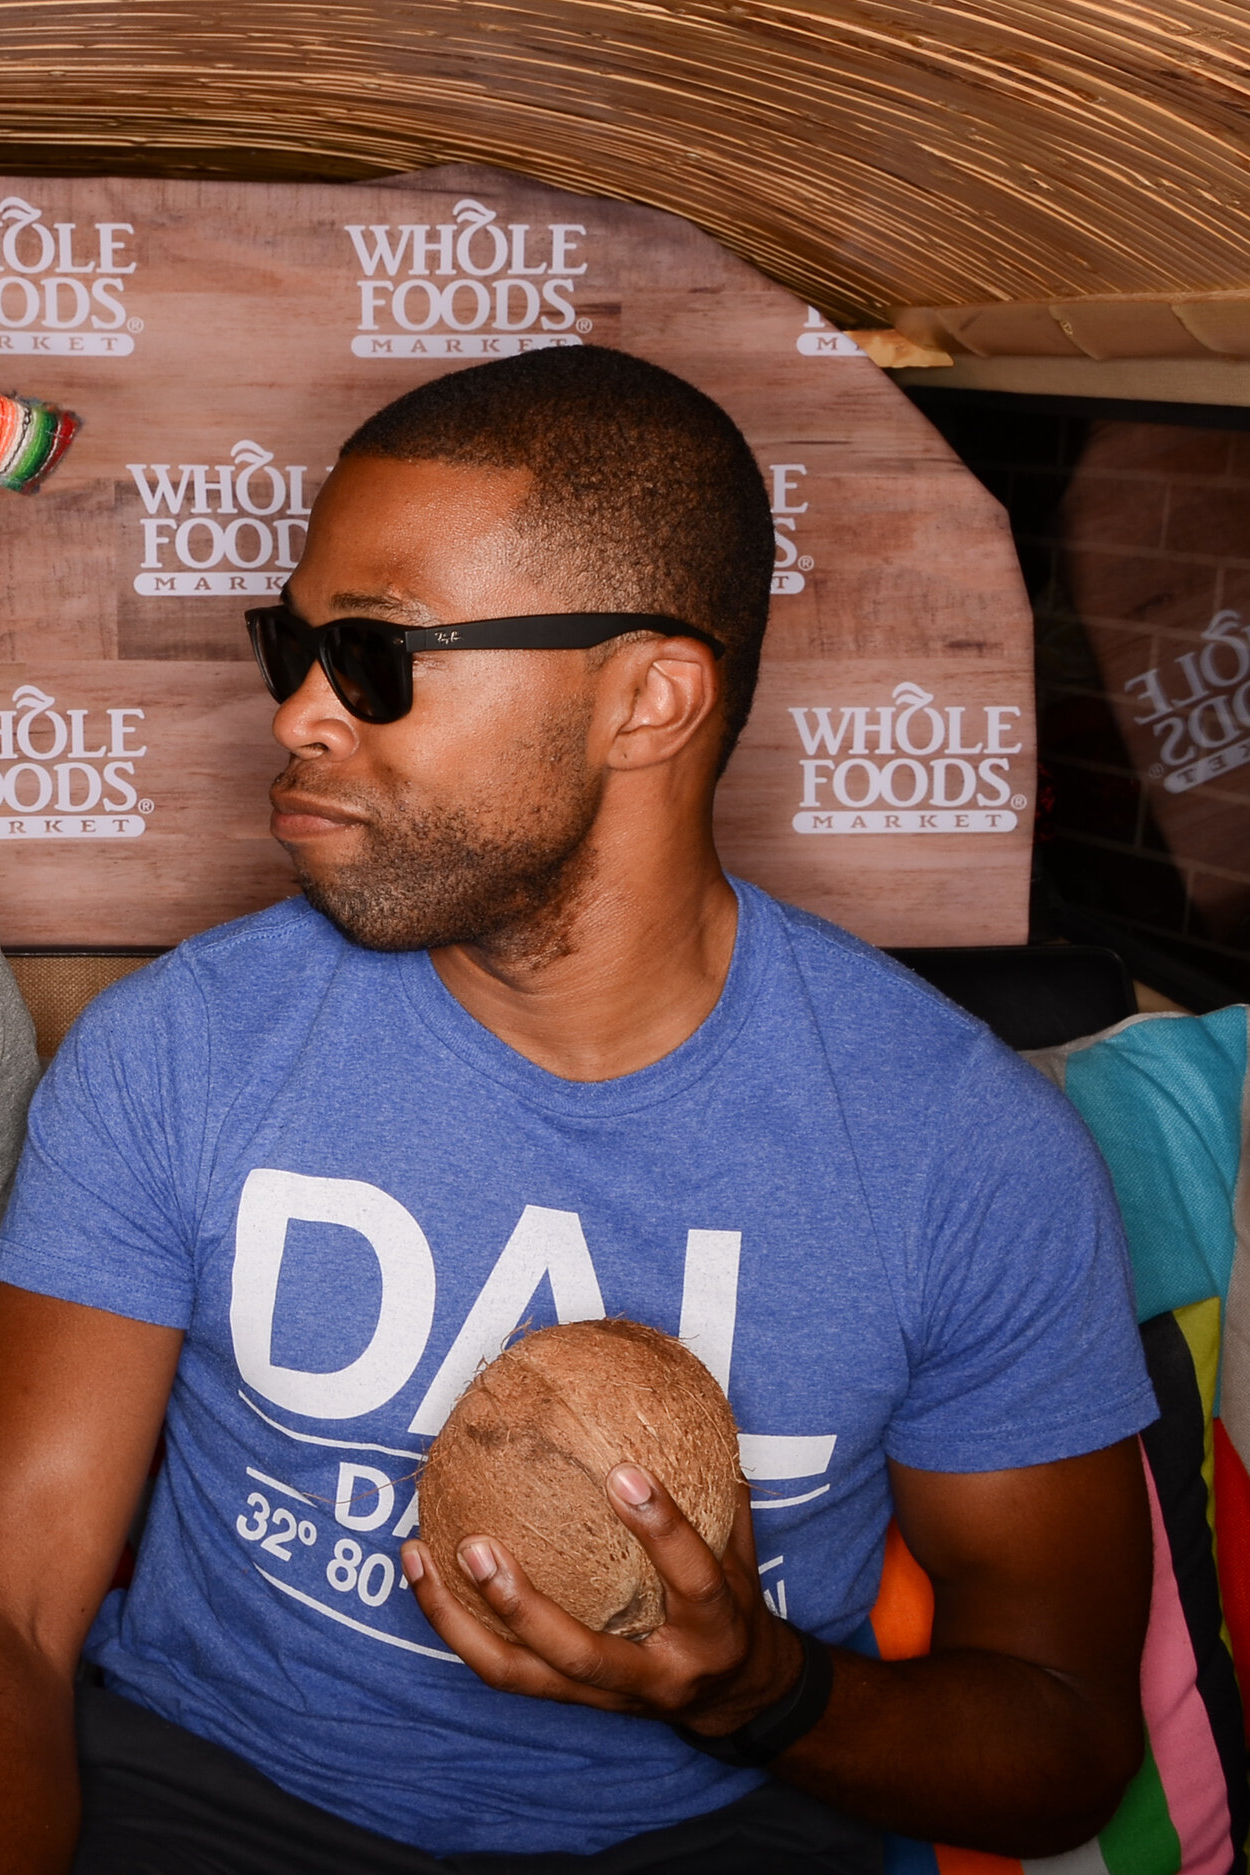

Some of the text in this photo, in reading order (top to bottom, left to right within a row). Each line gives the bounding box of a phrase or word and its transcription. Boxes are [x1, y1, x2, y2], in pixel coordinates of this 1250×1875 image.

[344, 198, 588, 276] WHOLE
[126, 440, 334, 515] WHOL
[139, 517, 309, 569] FOOD
[154, 576, 284, 591] MARK
[787, 681, 1022, 756] WHOLE
[812, 814, 1002, 829] MARKET
